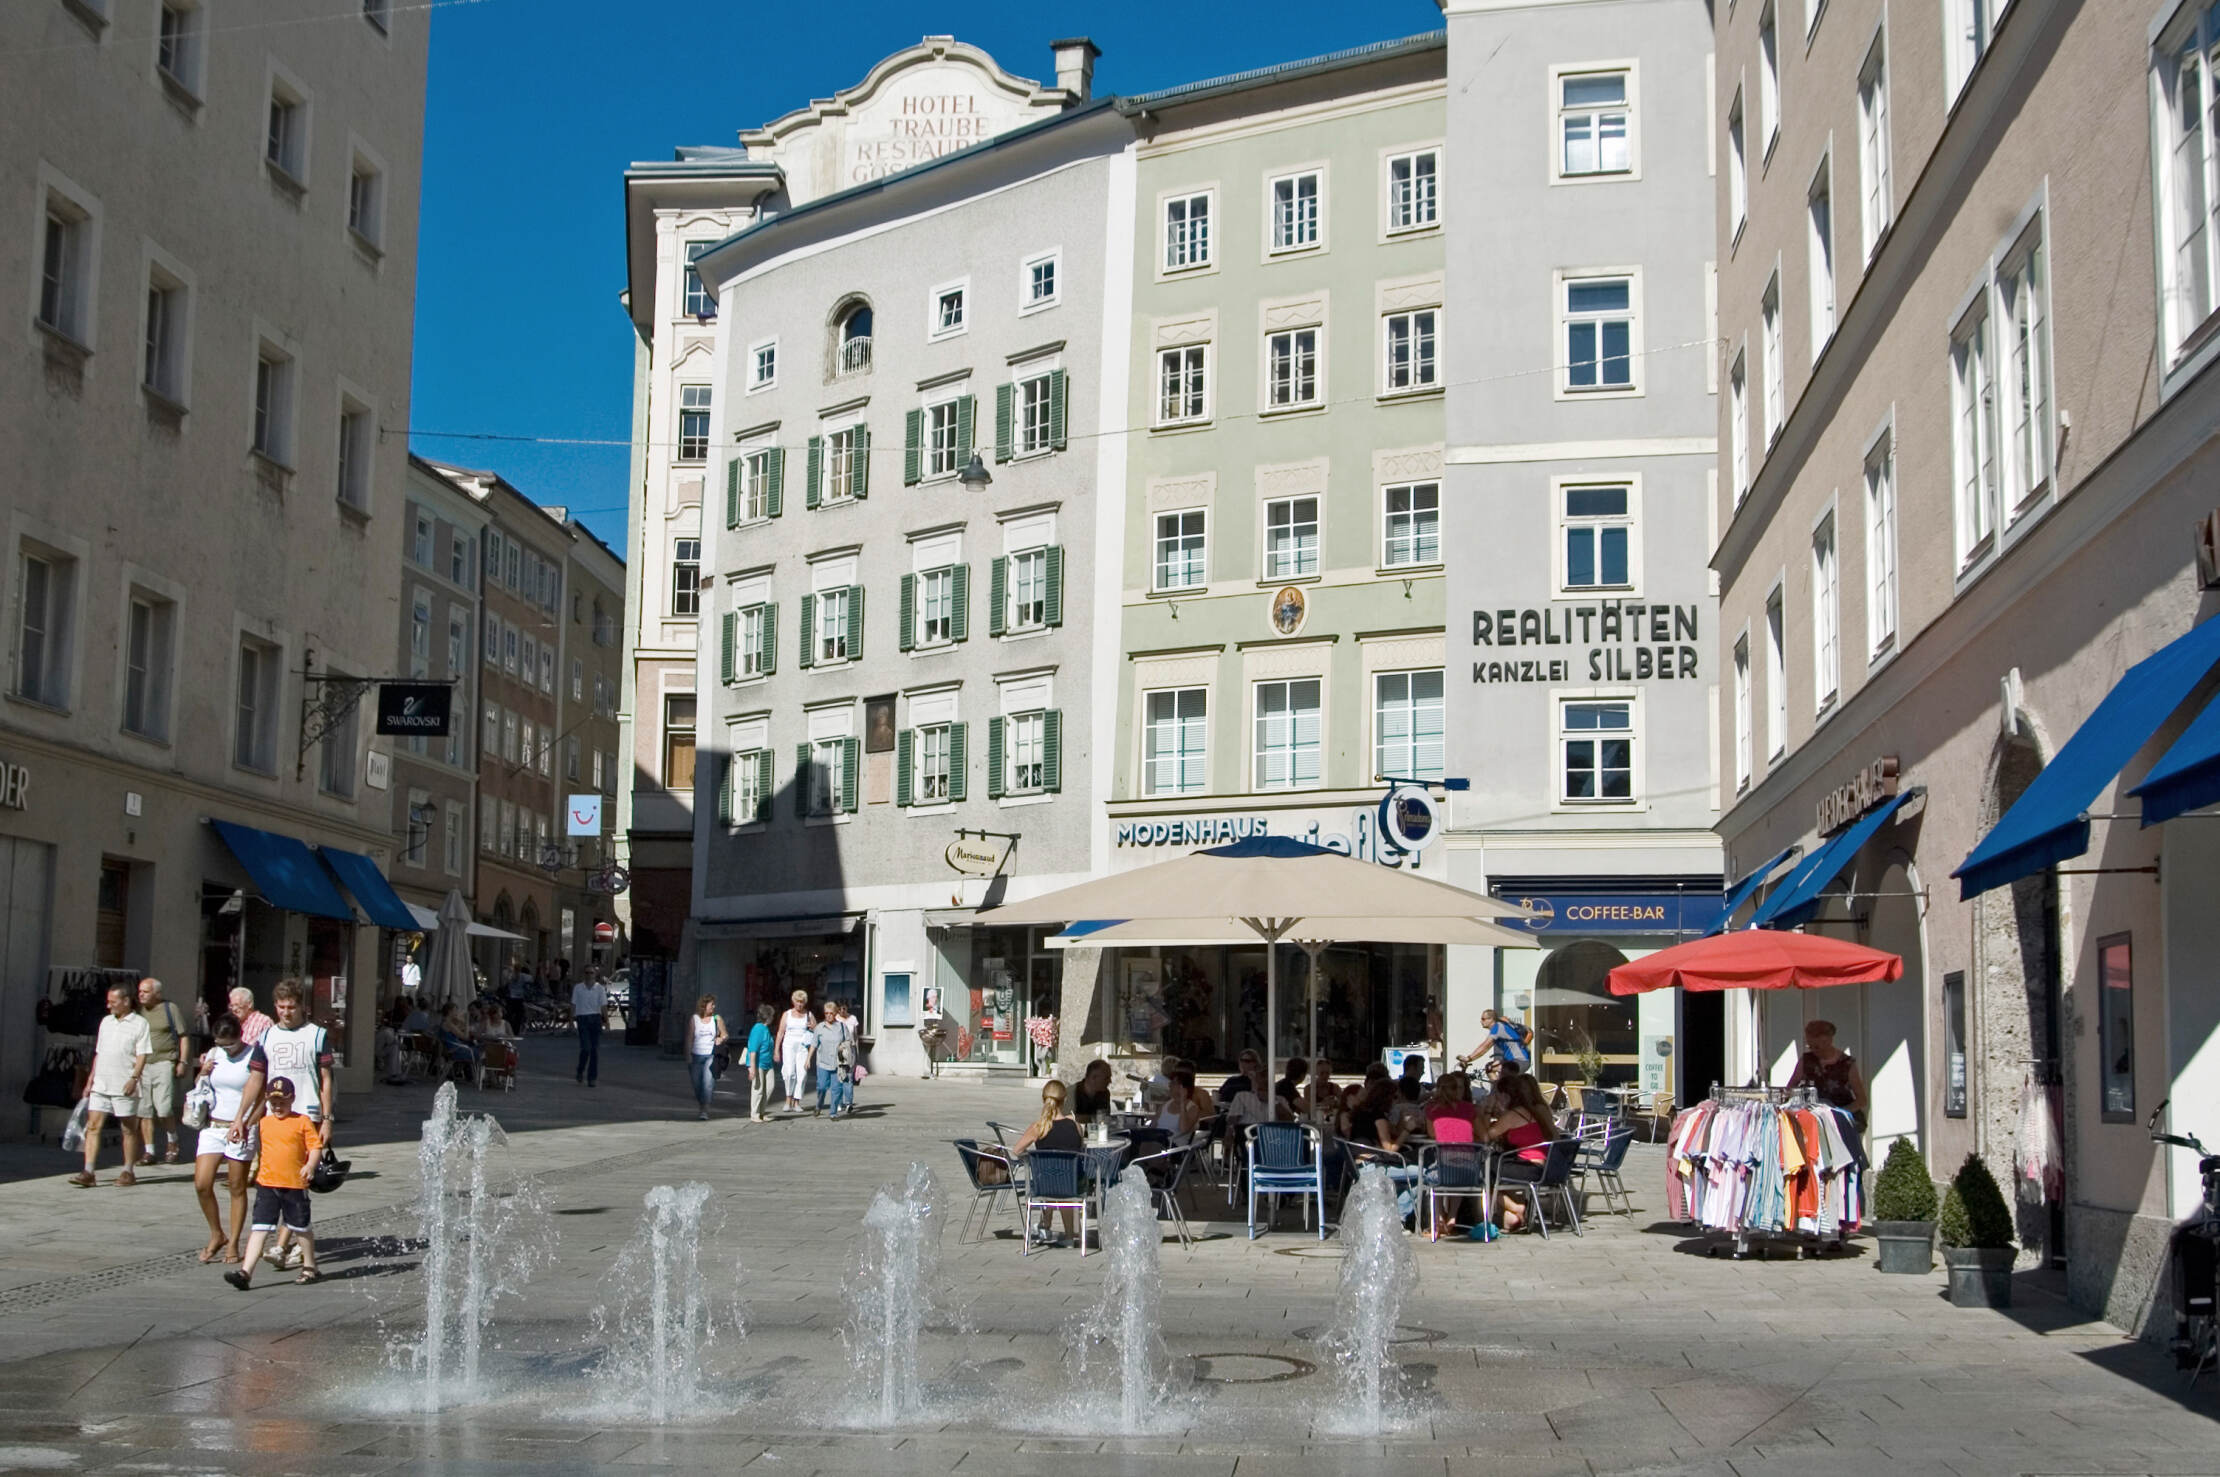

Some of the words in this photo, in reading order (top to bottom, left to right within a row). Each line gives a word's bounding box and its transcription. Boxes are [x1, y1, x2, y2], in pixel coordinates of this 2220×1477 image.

[902, 95, 980, 116] HOTEL
[889, 116, 990, 138] TRAUBE
[1473, 600, 1698, 646] REALITÄTEN
[1473, 660, 1568, 683] KANZLEI
[1589, 646, 1698, 681] SILBER
[386, 715, 441, 727] SWAROVSKI
[1115, 816, 1268, 848] MODENHAUS
[1566, 905, 1665, 921] COFFEE-BAR
[272, 1041, 307, 1071] 21
